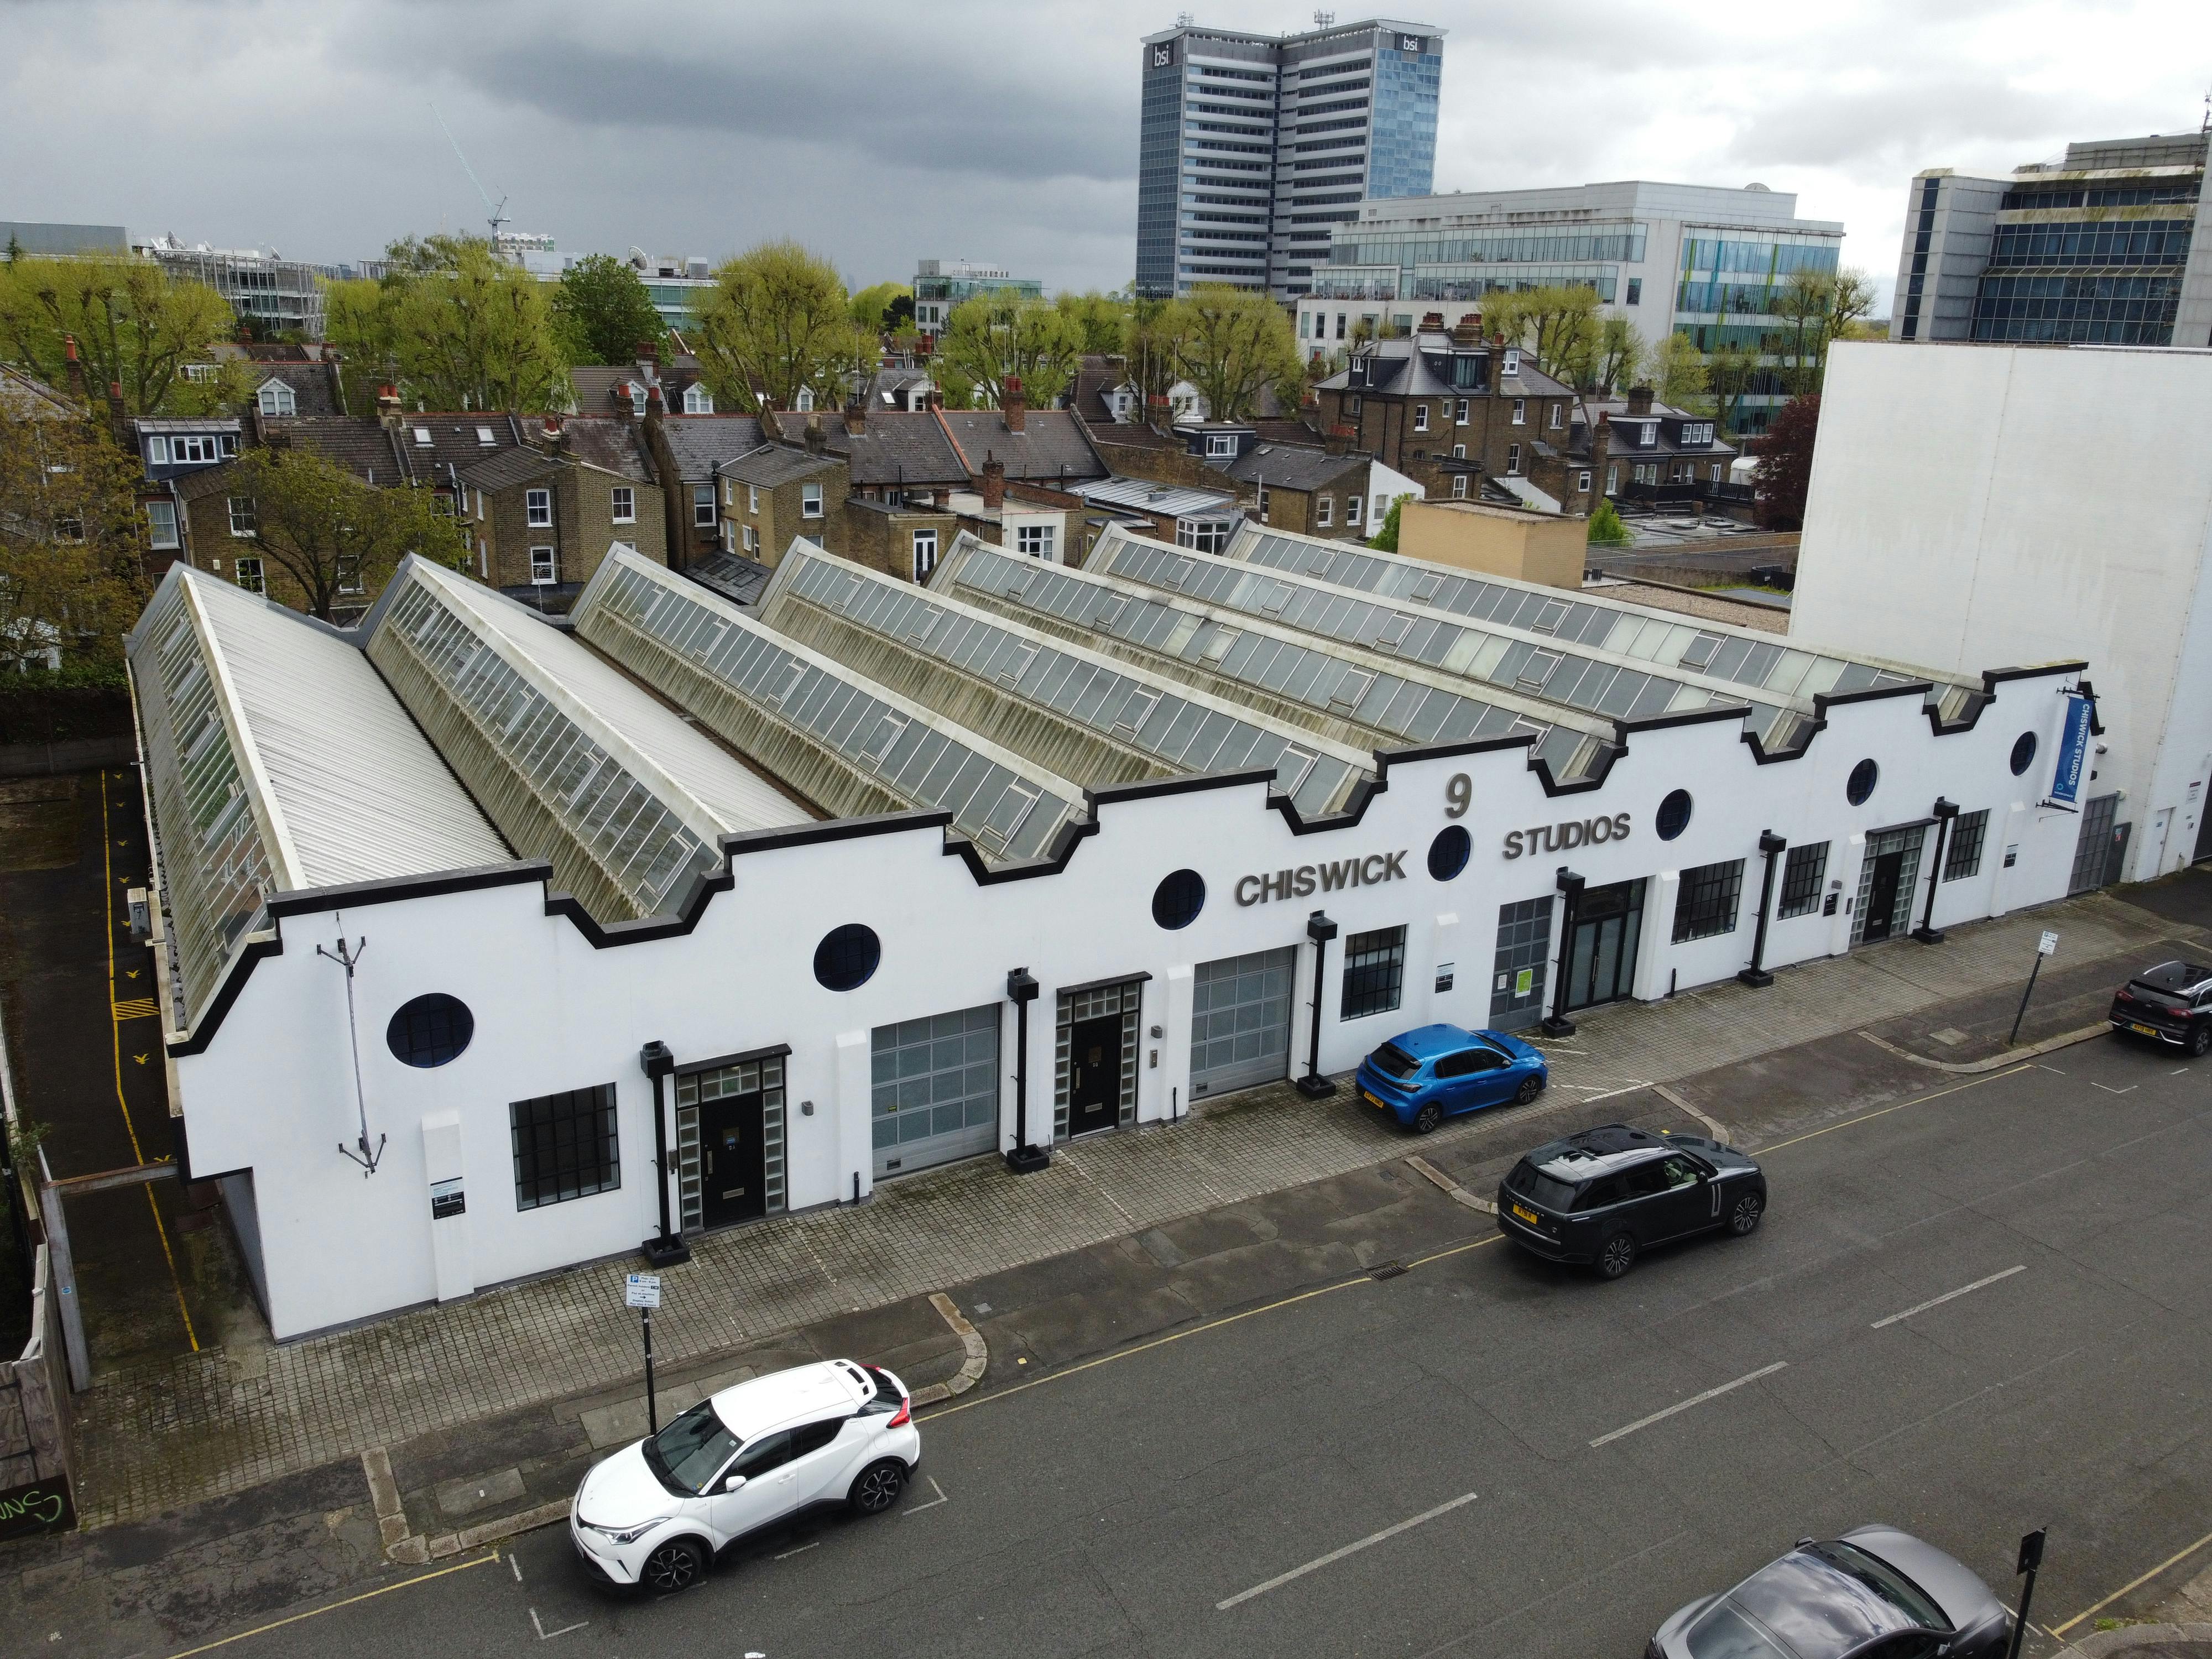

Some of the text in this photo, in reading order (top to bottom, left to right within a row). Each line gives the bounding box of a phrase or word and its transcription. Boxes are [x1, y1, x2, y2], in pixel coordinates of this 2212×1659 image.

[1155, 44, 1168, 66] bsi
[1404, 35, 1417, 51] bsi
[2068, 703, 2090, 785] CHISWICK STUDIOS
[1444, 773, 1472, 818] 9
[1234, 812, 1631, 907] CHISWICK STUDIOS
[1525, 1206, 1545, 1217] ROVER
